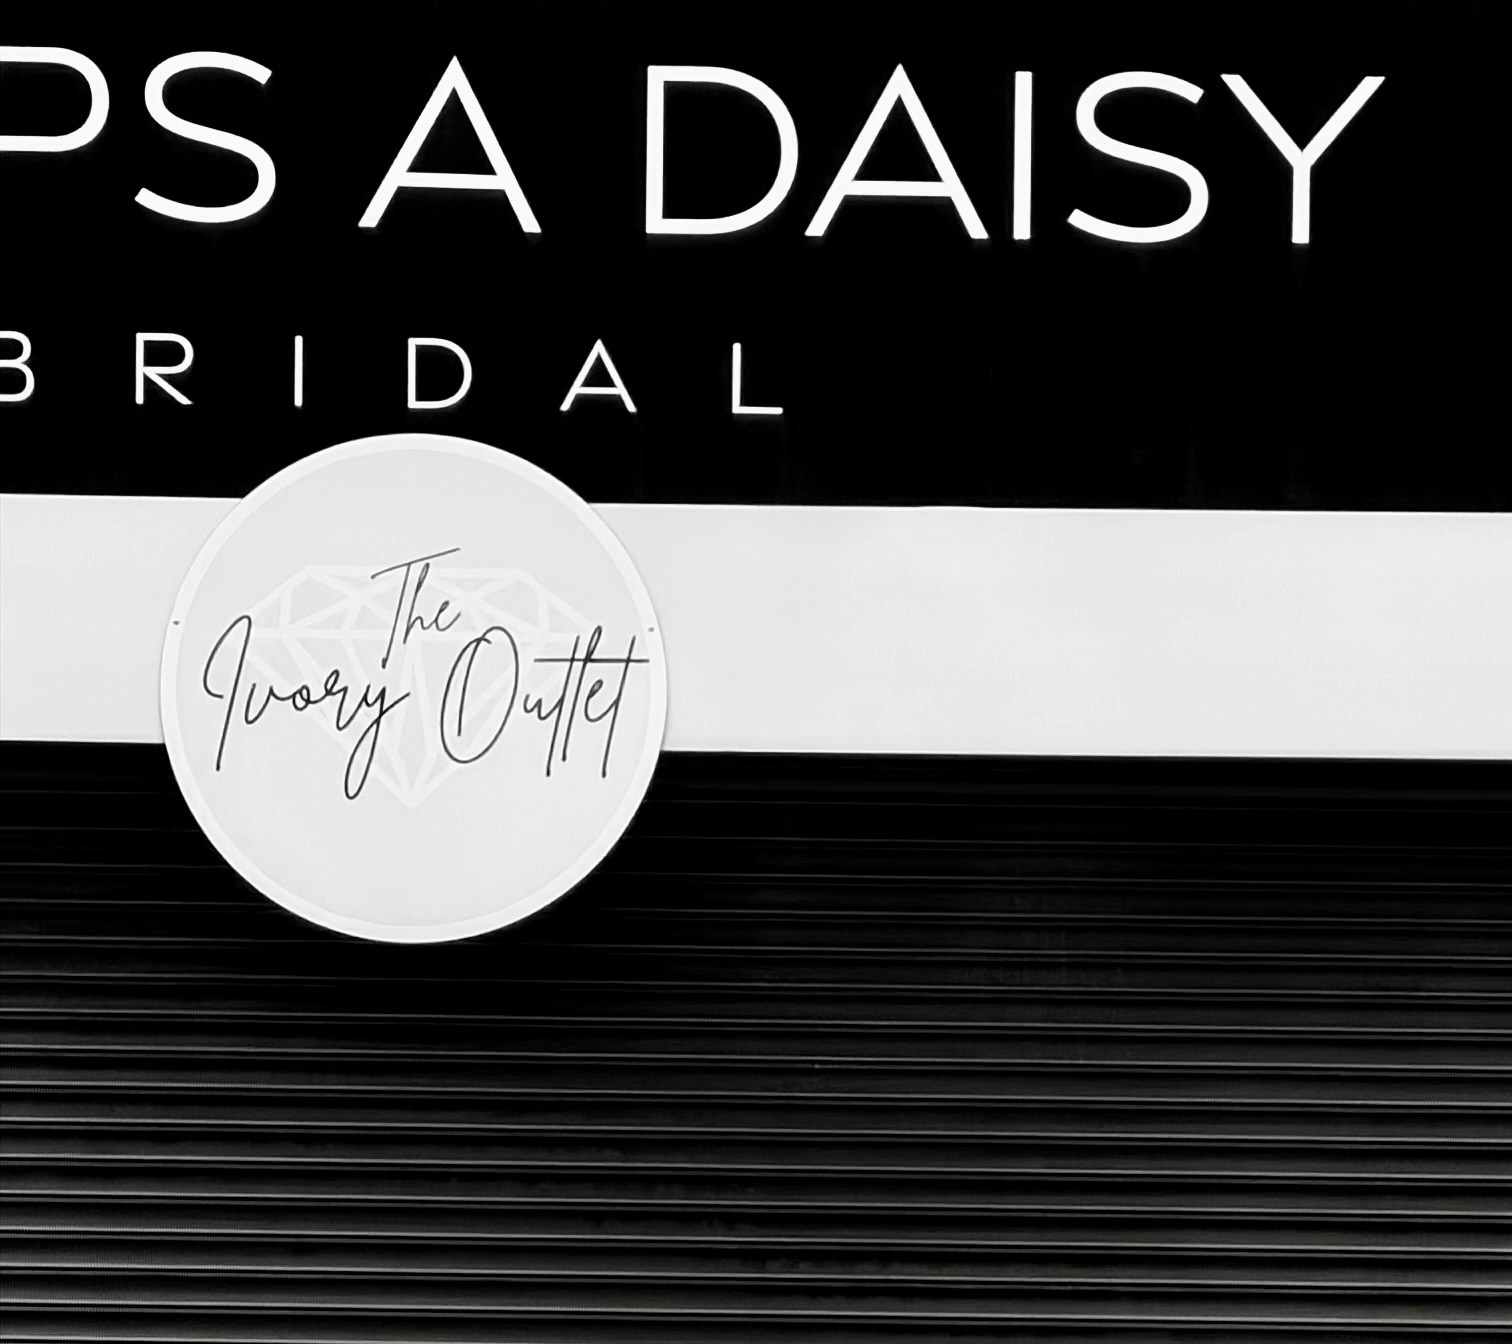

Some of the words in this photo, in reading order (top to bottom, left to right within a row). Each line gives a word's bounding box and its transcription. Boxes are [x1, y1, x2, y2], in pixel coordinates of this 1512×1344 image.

[0, 45, 277, 224] PS
[357, 55, 542, 234] A
[645, 63, 1386, 245] DAISY
[0, 330, 784, 415] BRIDAL
[371, 547, 461, 669] The
[203, 614, 410, 801] Ivory
[440, 625, 650, 779] Outlet
